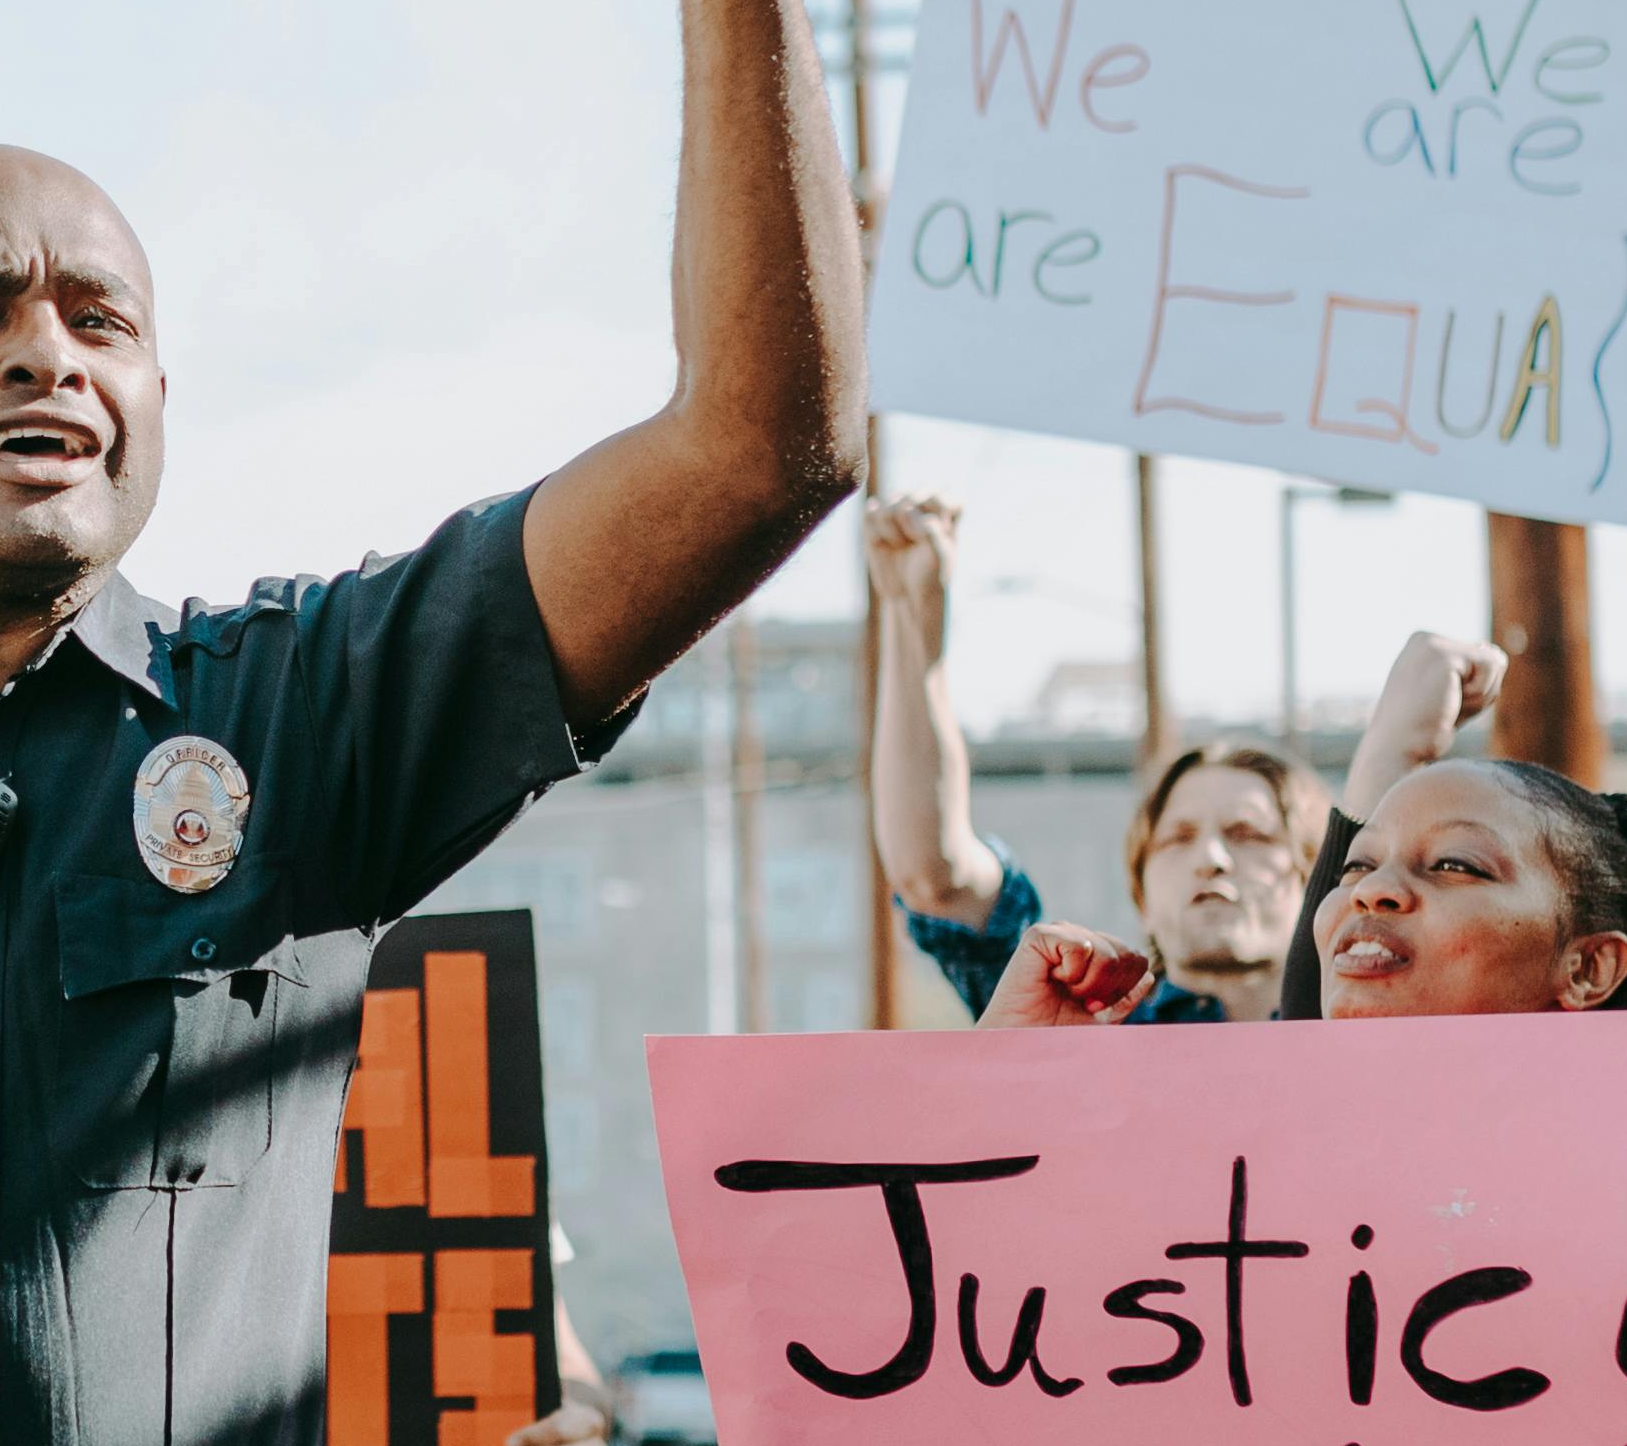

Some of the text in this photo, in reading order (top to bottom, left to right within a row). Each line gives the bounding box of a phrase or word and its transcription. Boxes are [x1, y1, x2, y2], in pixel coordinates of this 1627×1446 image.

[1362, 97, 1585, 195] are
[911, 198, 1102, 306] are
[165, 745, 226, 772] OFFICER
[144, 833, 233, 864] PRIVATE SECURITY
